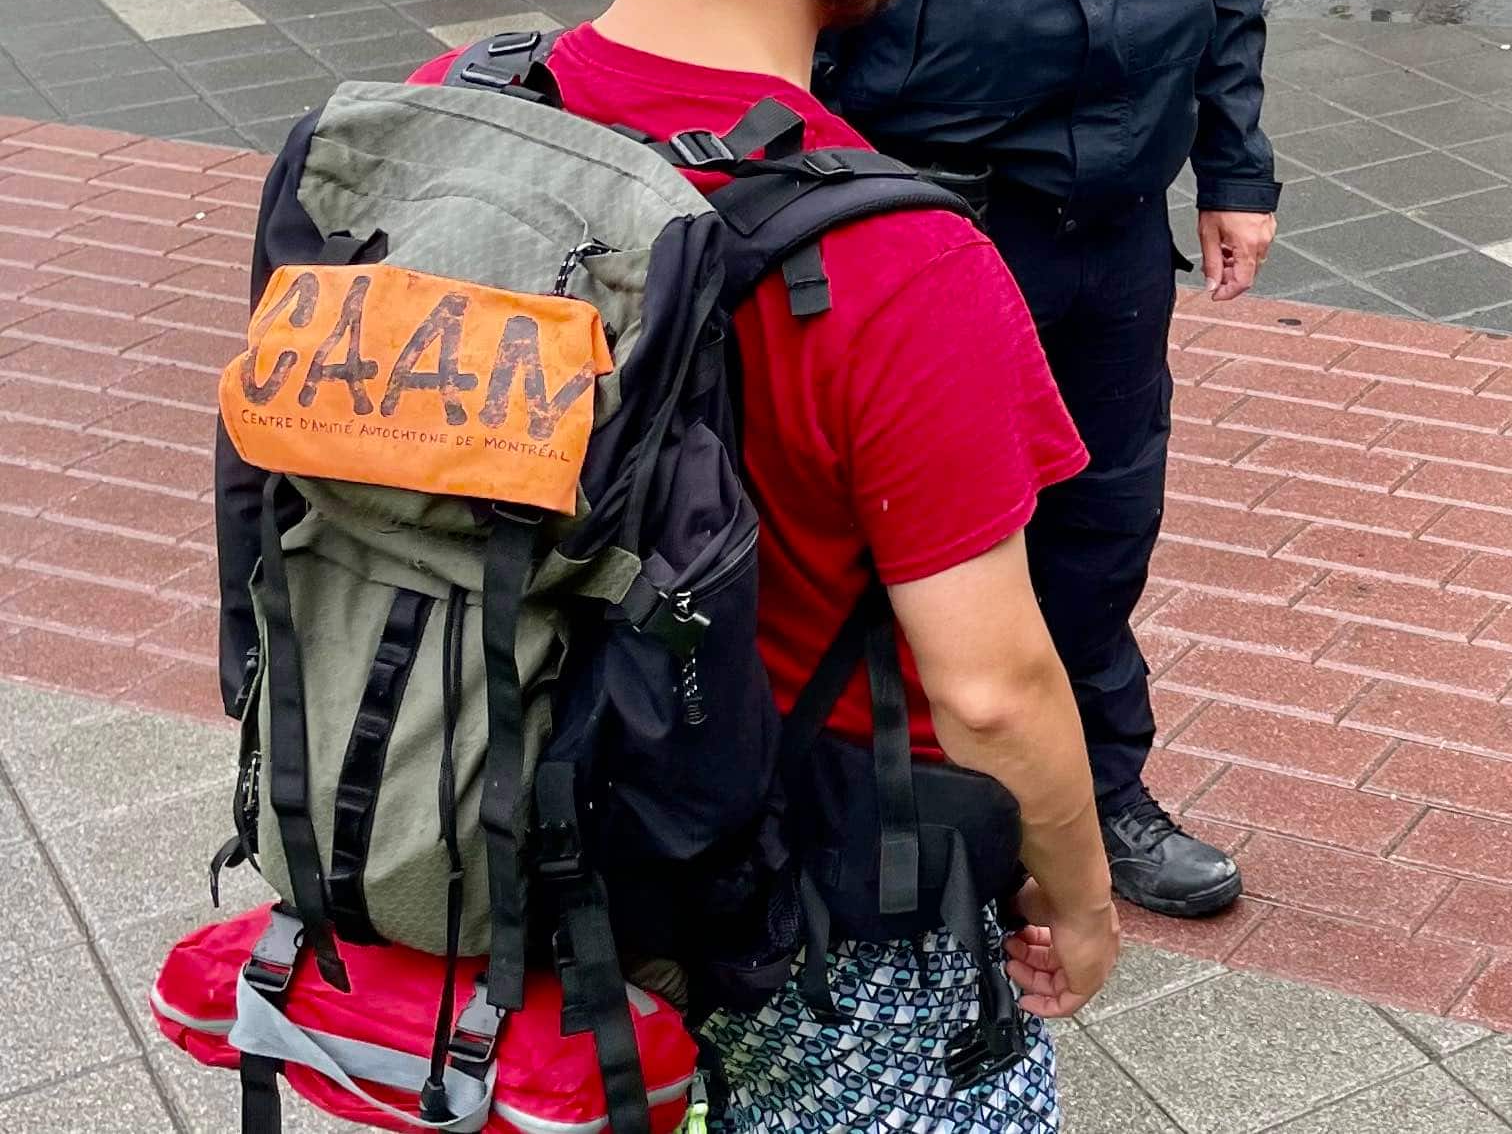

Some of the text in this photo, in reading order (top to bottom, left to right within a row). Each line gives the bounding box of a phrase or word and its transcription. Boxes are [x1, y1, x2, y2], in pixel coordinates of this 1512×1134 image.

[241, 409, 571, 462] CENTRE D'AMITIÉ AUTOCHTONE DE MONTRÉAL
